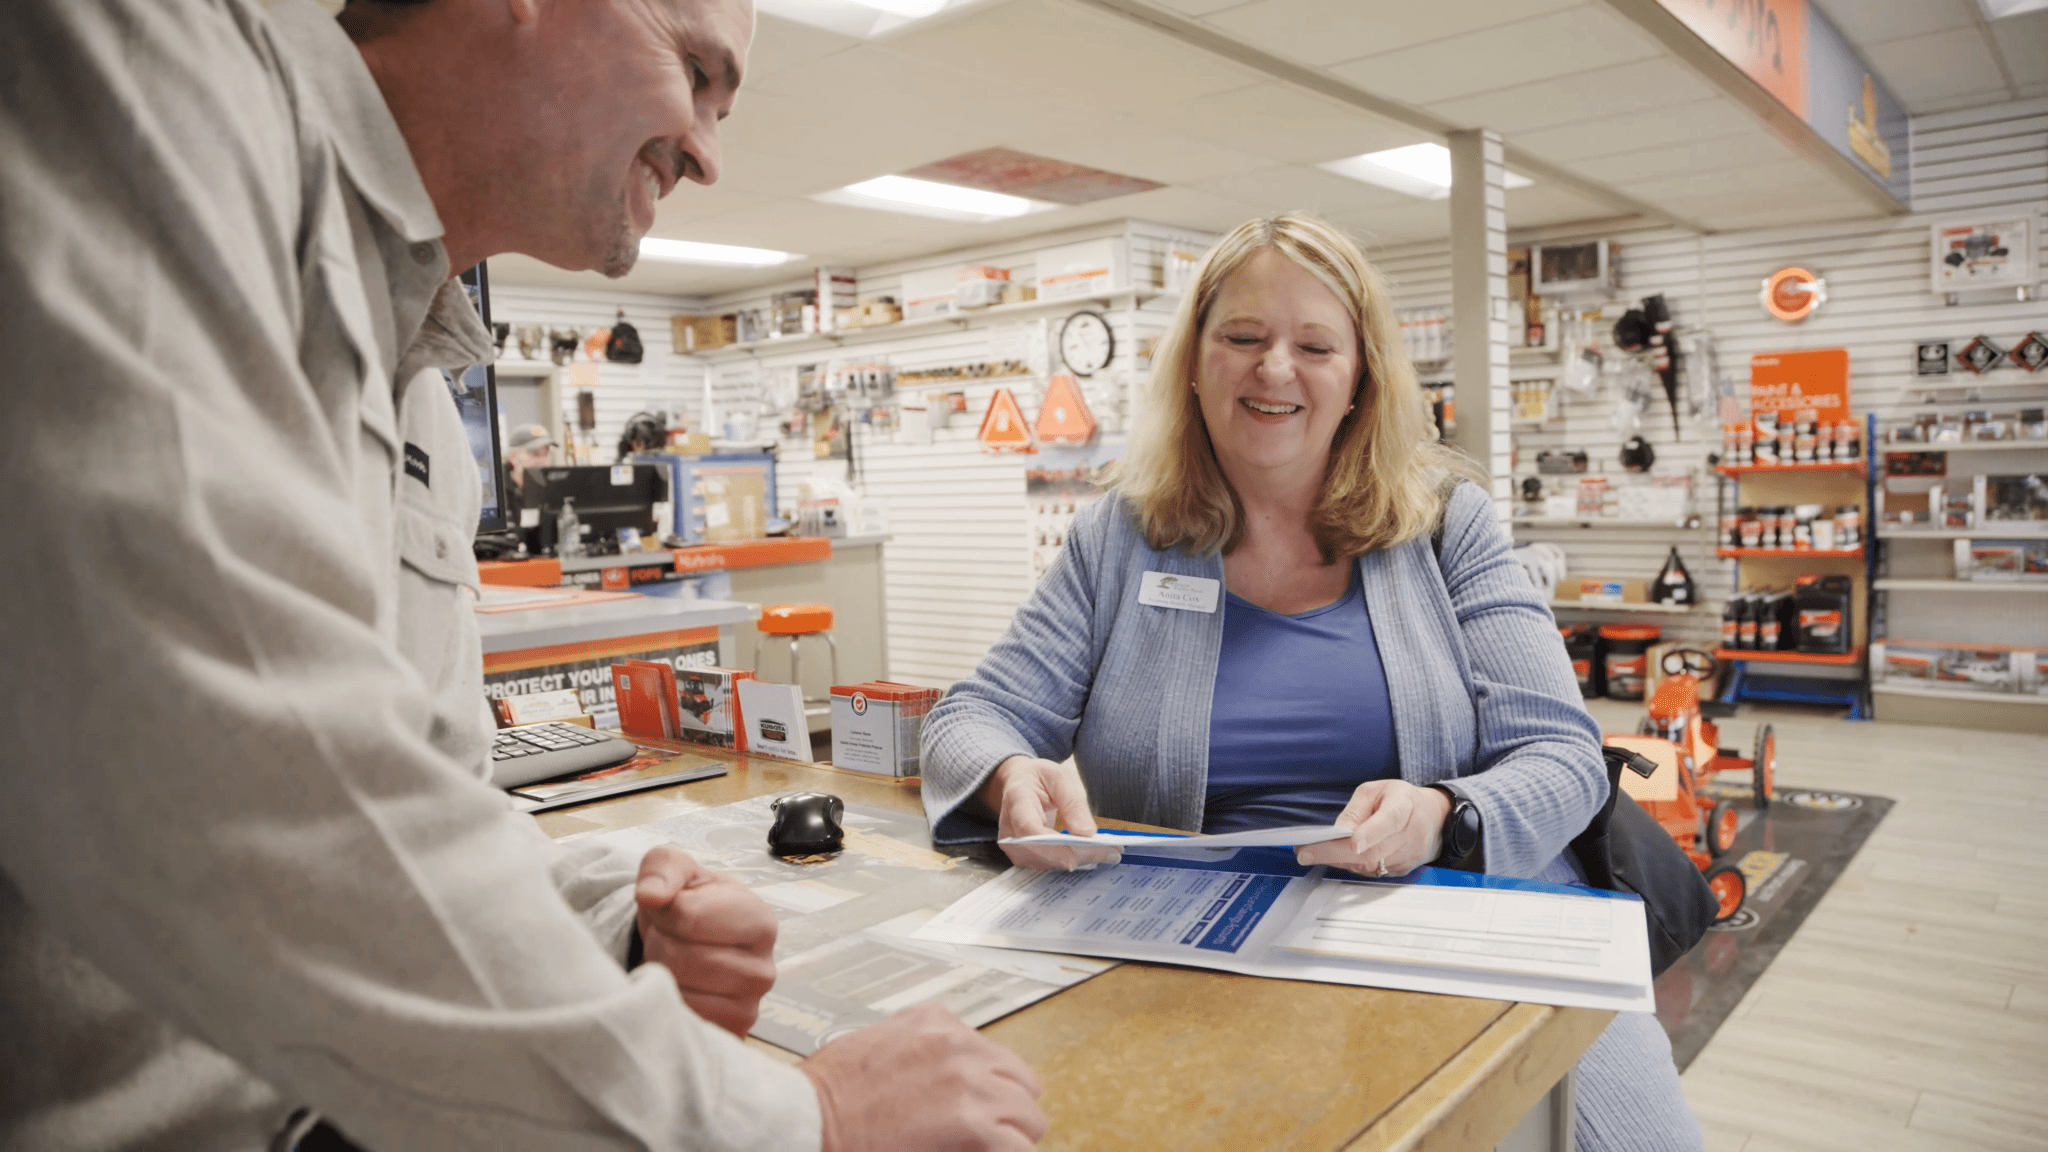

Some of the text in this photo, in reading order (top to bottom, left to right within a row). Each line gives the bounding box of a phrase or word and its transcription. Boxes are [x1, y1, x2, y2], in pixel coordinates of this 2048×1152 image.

[1158, 591, 1199, 603] Anita Cox
[675, 650, 717, 671] ONES
[483, 674, 565, 700] PROTECT
[760, 723, 786, 732] KUBOTA
